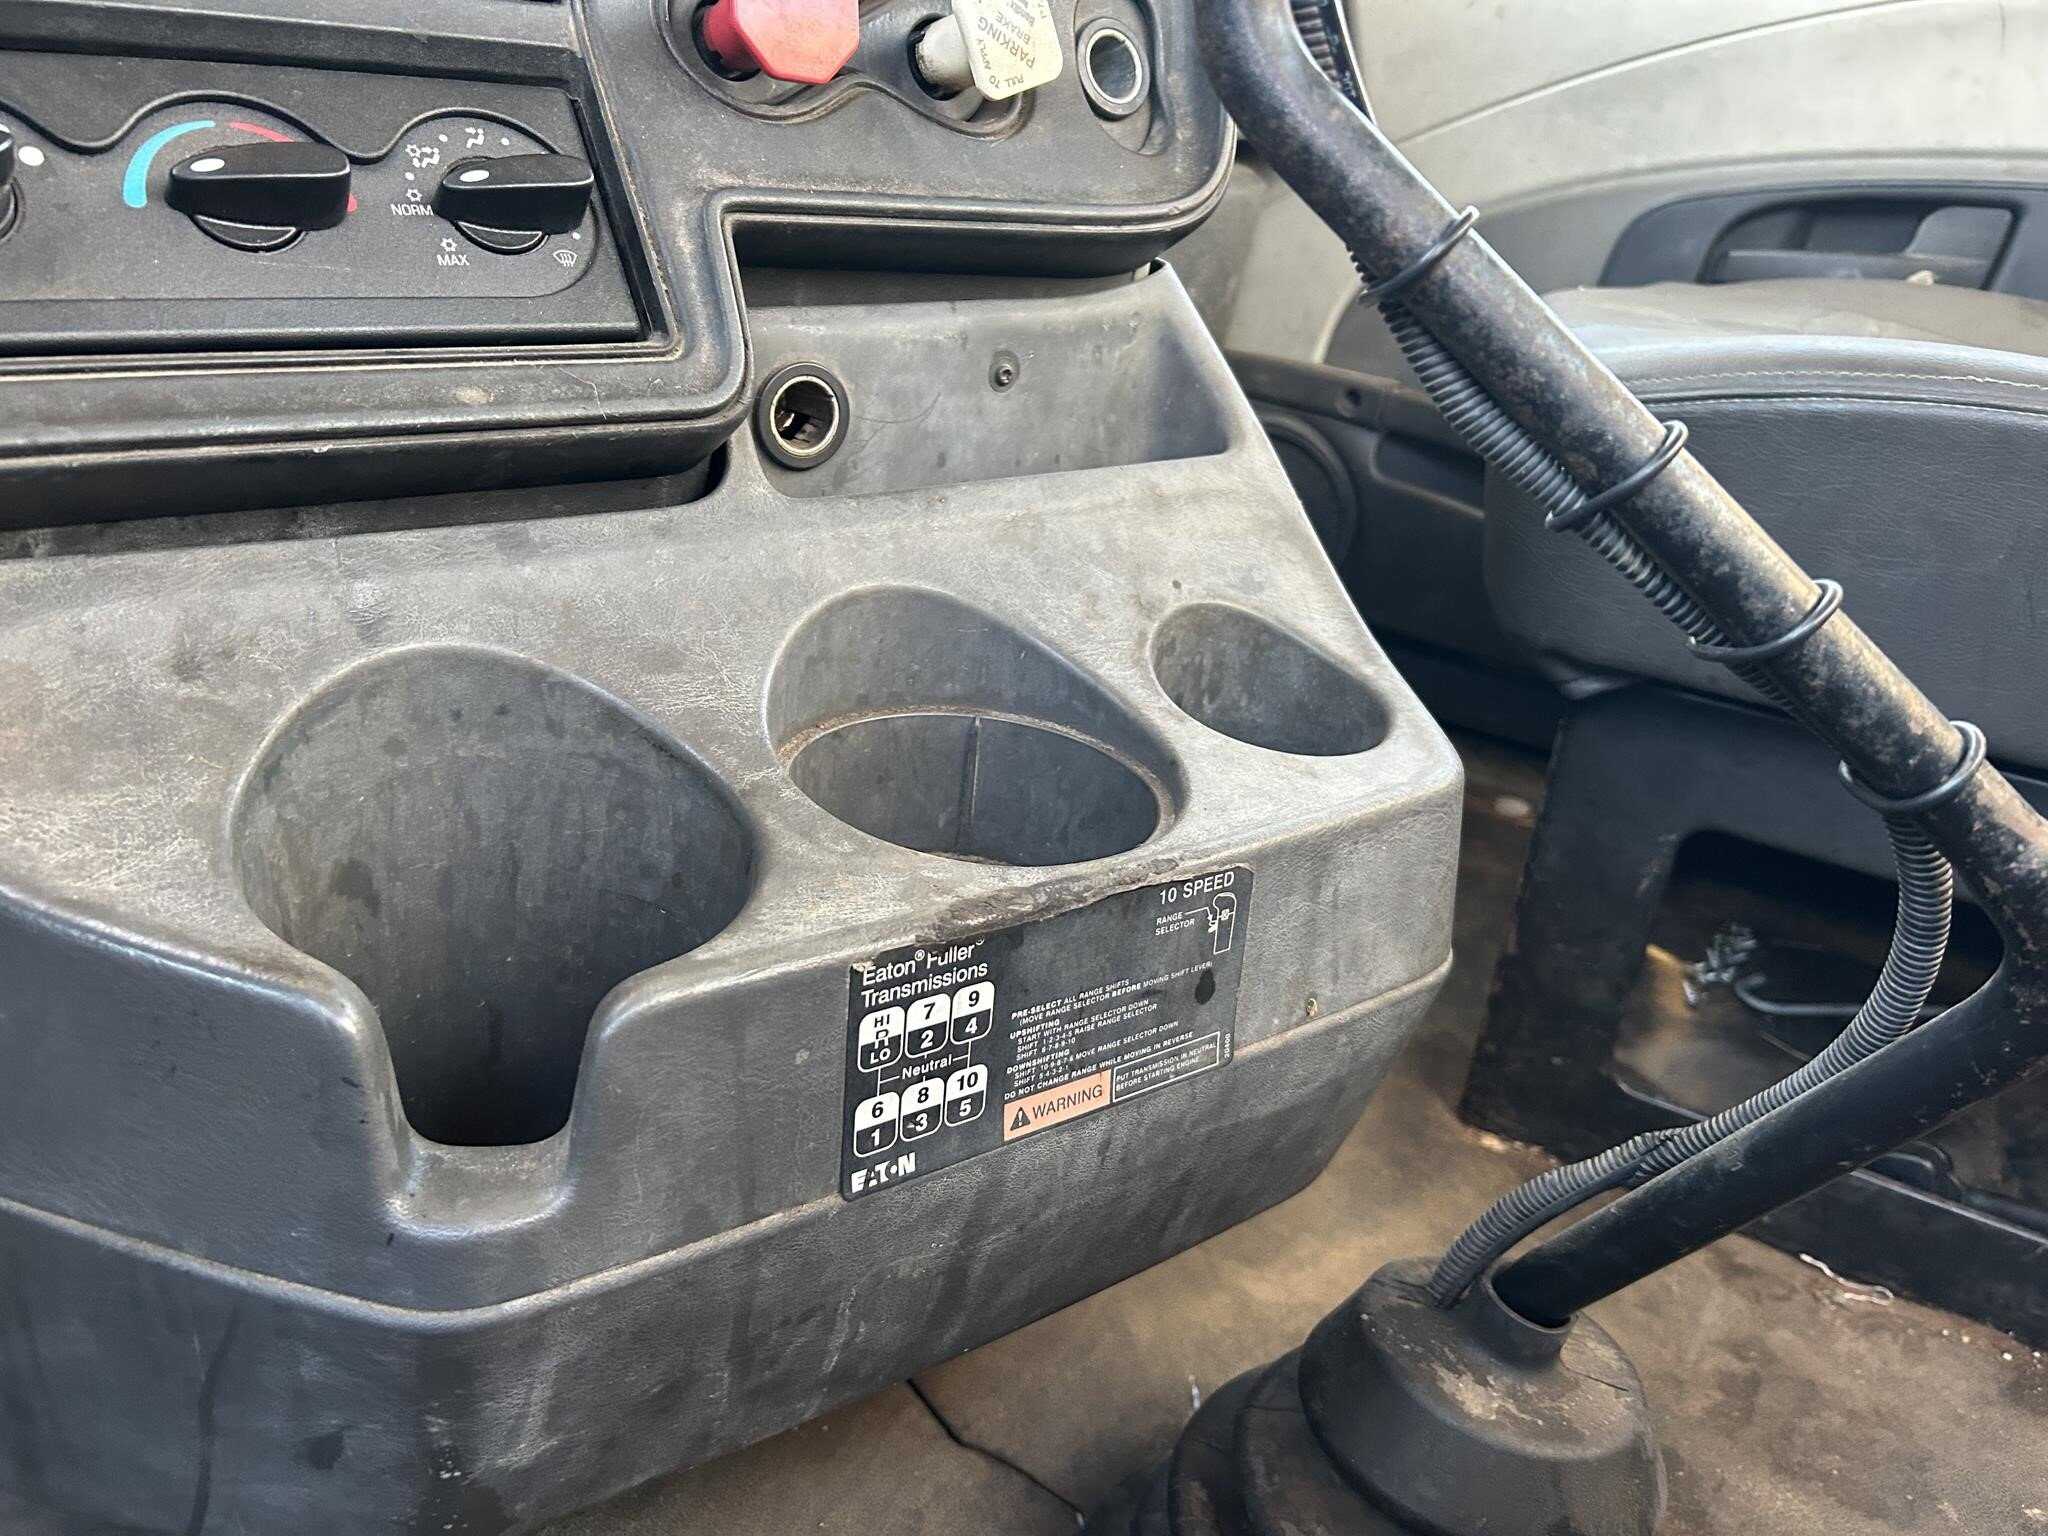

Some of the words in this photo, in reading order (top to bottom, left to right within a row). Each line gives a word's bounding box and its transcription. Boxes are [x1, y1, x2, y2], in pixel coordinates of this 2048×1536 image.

[995, 11, 1031, 45] BRAKE
[977, 16, 1036, 69] PARKING
[390, 203, 434, 216] NORM
[436, 254, 470, 266] MAX
[1160, 887, 1177, 905] 10
[1183, 871, 1235, 898] SPEED
[1155, 919, 1195, 936] SELECTOR
[1156, 912, 1183, 926] RANGE
[861, 962, 988, 1008] Transmissions
[1045, 1004, 1071, 1018] RANGE
[1073, 993, 1110, 1009] SELECTOR
[1111, 983, 1141, 998] BEFORE
[1143, 975, 1169, 988] MOVING
[1171, 967, 1189, 979] SHIFT
[968, 990, 980, 1008] 9
[1011, 1000, 1061, 1020] PRE-SELECT
[1064, 996, 1076, 1005] ALL
[1079, 987, 1103, 999] RANGE
[1105, 979, 1130, 991] SHIFTS
[874, 1014, 890, 1027] HI
[924, 1002, 936, 1020] 7
[965, 1017, 978, 1034] 4
[1009, 1019, 1060, 1040] UPSHIFTING
[1017, 1040, 1038, 1053] SHIFT
[1074, 1023, 1095, 1035] RAISE
[1097, 1015, 1121, 1028] RANGE
[1123, 1003, 1157, 1020] SELECTOR
[1018, 1032, 1041, 1045] START
[1043, 1025, 1062, 1037] WITH
[1064, 1018, 1089, 1030] RANGE
[1090, 1005, 1127, 1022] SELECTOR
[1128, 1000, 1149, 1011] DOWN
[875, 1029, 889, 1049] R
[920, 1030, 934, 1049] 2
[870, 1048, 891, 1064] LO
[1014, 1067, 1036, 1080] SHIFT
[1076, 1048, 1095, 1060] MOVE
[1097, 1039, 1121, 1052] RANGE
[1123, 1027, 1157, 1044] SELECTOR
[1159, 1021, 1179, 1032] DOWN
[1016, 1048, 1038, 1061] SHIFT
[902, 1053, 952, 1080] Neutral
[1004, 1092, 1016, 1101] DO
[1018, 1085, 1035, 1096] NOT
[1037, 1073, 1069, 1089] CHANGE
[1071, 1064, 1097, 1077] RANGE
[1099, 1055, 1122, 1069] WHILE
[1124, 1046, 1151, 1060] MOVING
[1163, 1031, 1193, 1047] REVERSE
[1007, 1049, 1070, 1074] DOWNSHIFTING
[1117, 1072, 1129, 1082] PUT
[1131, 1056, 1179, 1076] TRANSMISSION
[1188, 1043, 1217, 1057] NEUTRAL
[957, 1071, 978, 1091] 10
[1014, 1074, 1036, 1087] SHIFT
[1116, 1077, 1142, 1091] BEFORE
[1143, 1065, 1175, 1081] STARTING
[1176, 1056, 1200, 1069] ENGINE
[917, 1087, 929, 1104] 8
[1032, 1084, 1103, 1119] WARNING
[872, 1101, 884, 1119] 6
[959, 1098, 972, 1117] 5
[915, 1112, 928, 1132] 3
[871, 1128, 880, 1146] 1
[851, 1152, 916, 1193] EATON
